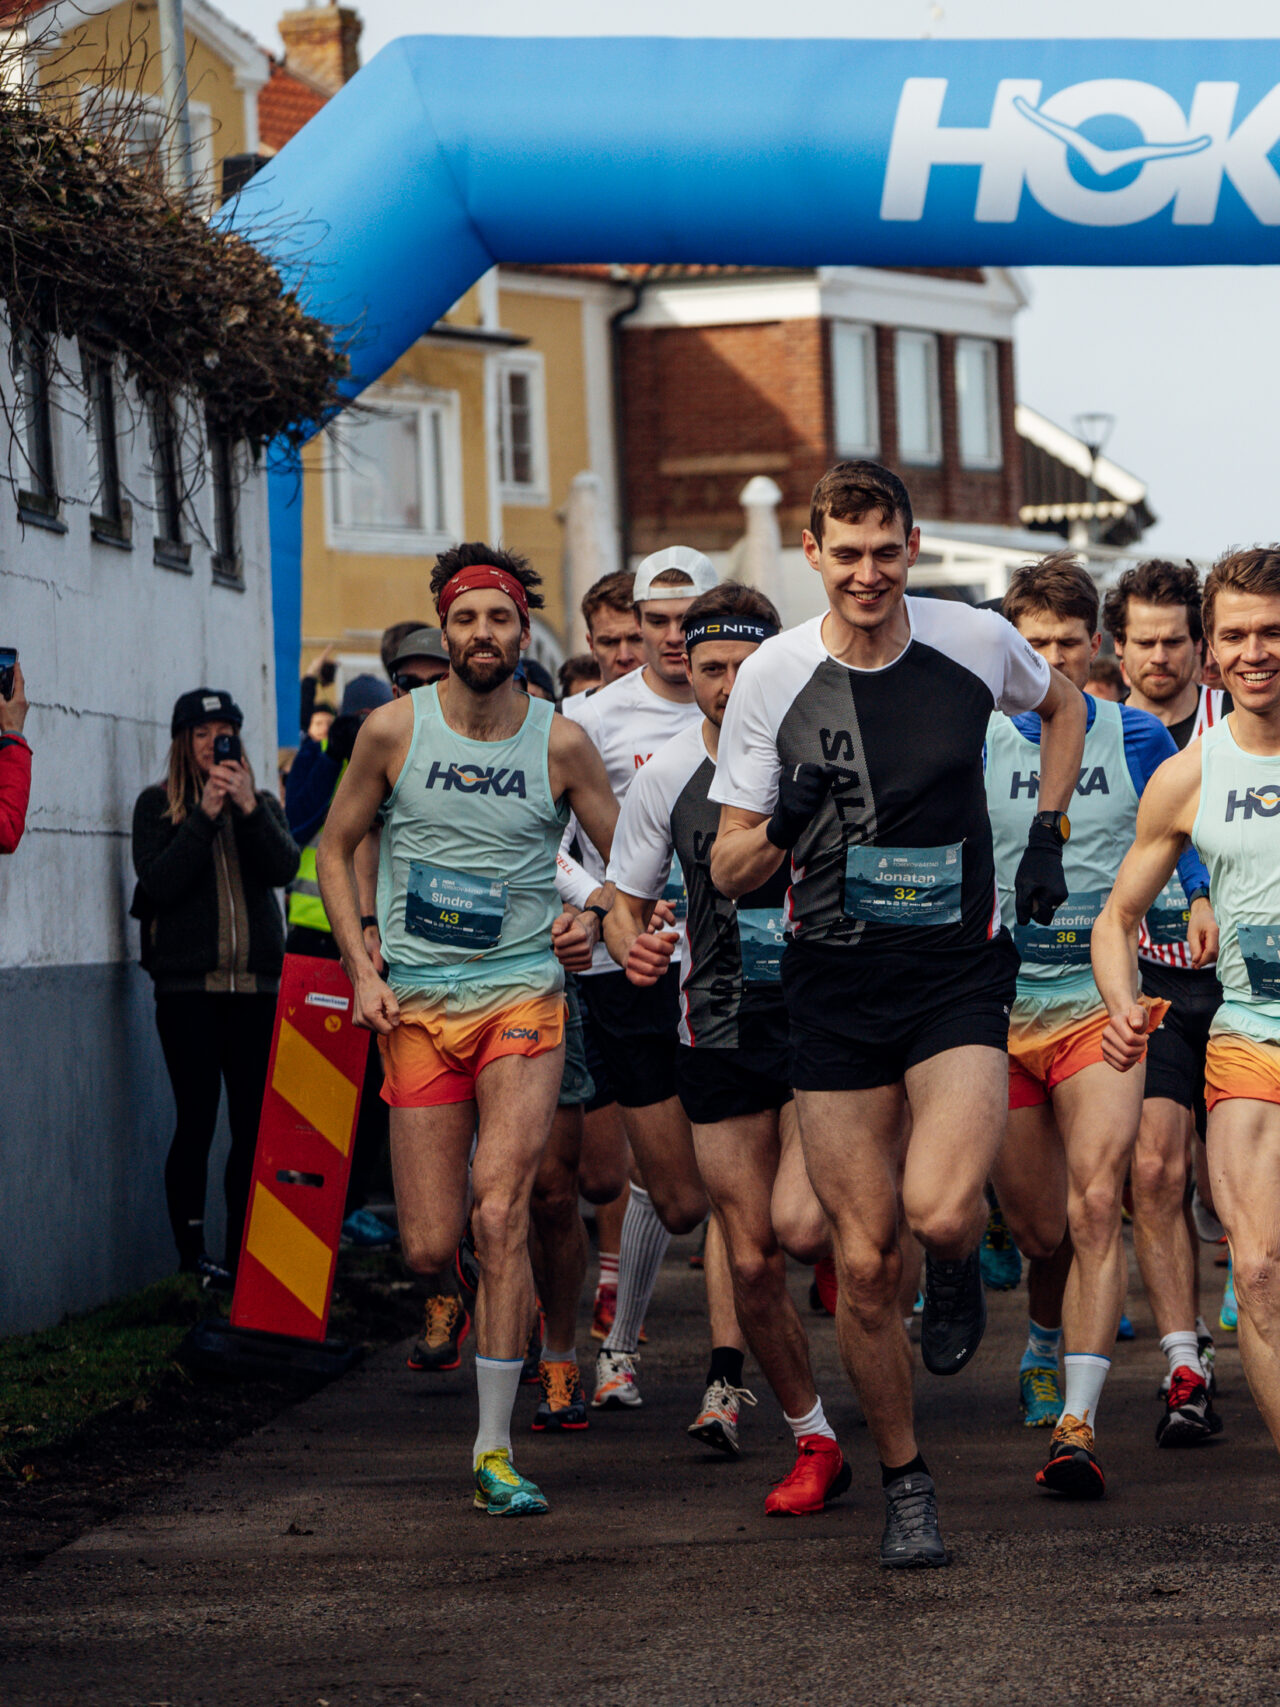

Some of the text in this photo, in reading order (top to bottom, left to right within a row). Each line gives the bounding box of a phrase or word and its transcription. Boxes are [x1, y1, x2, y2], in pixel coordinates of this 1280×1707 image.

[425, 761, 527, 799] HOKA
[1009, 766, 1110, 800] HKA
[874, 871, 936, 883] Jonatan
[431, 892, 473, 909] Sindre
[894, 887, 917, 901] 32
[439, 910, 460, 925] 43
[1056, 931, 1076, 943] 36
[501, 1027, 540, 1043] HOKA
